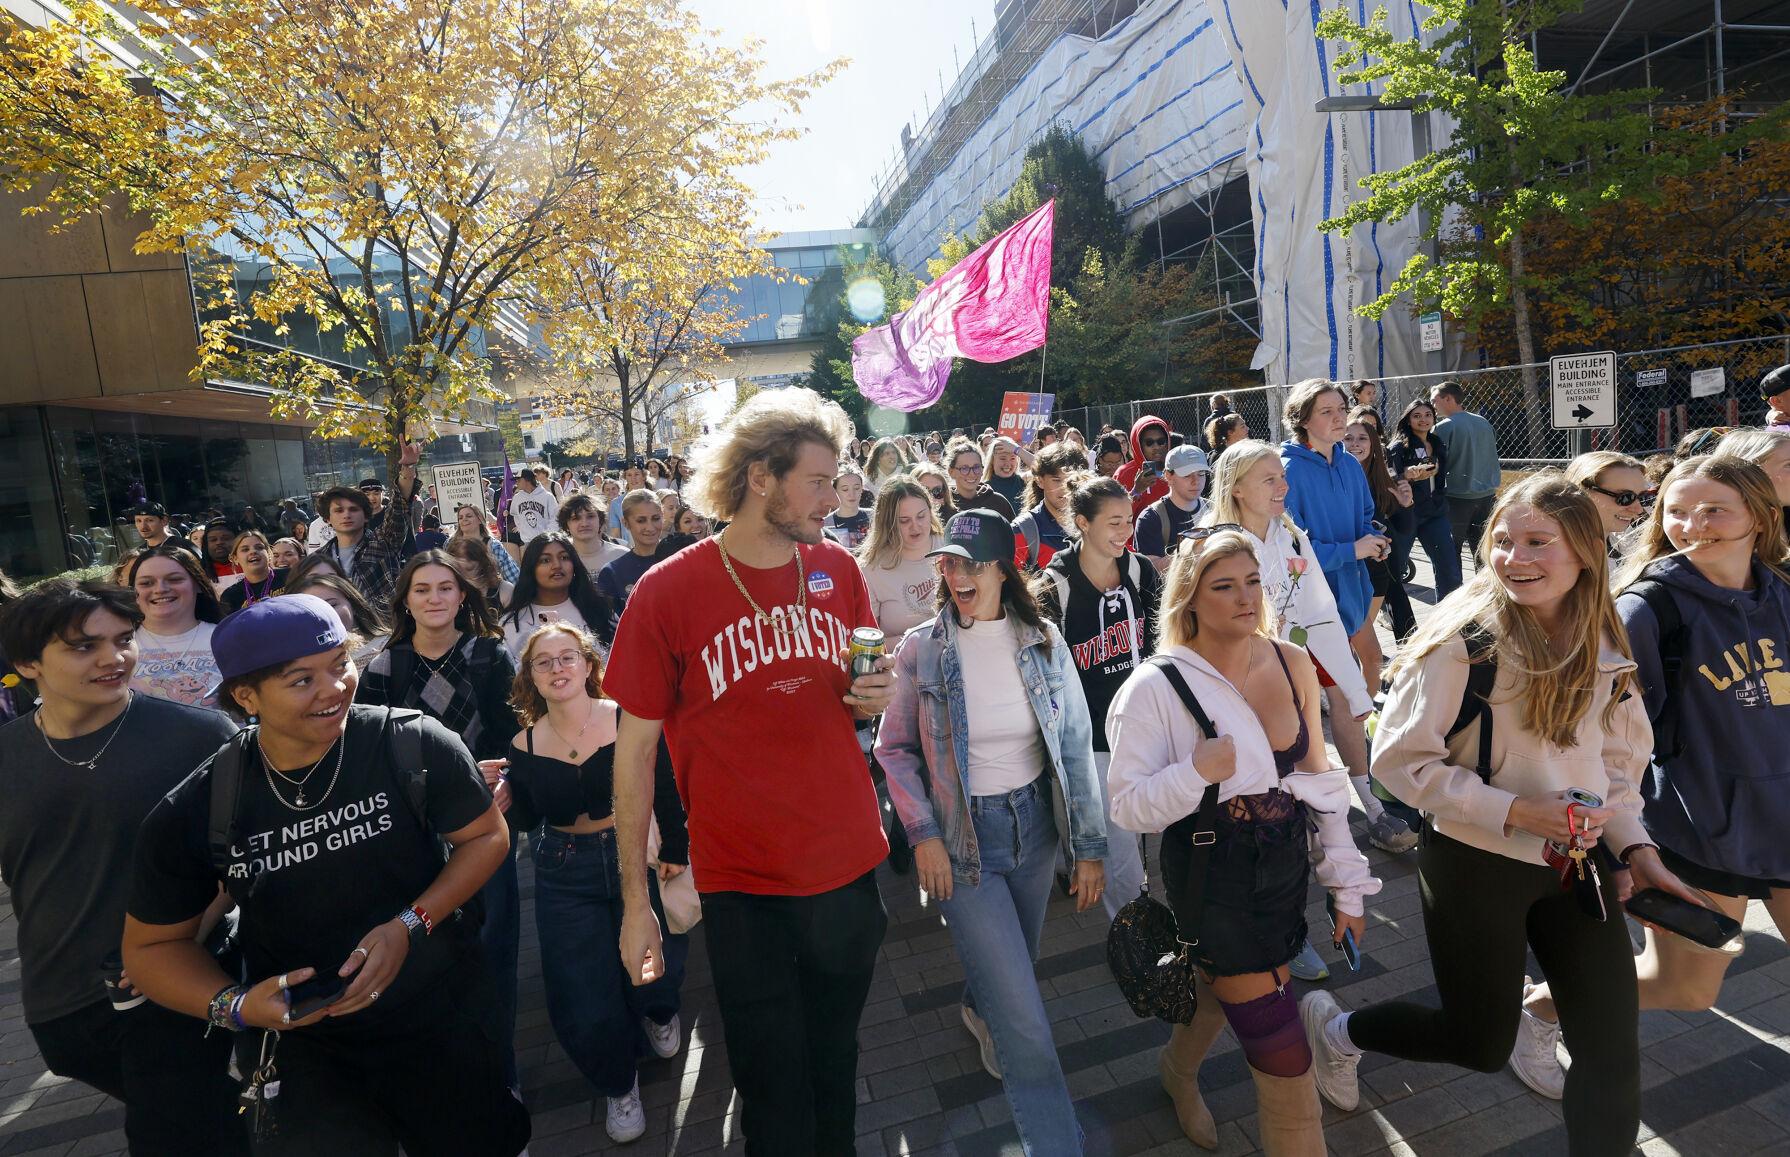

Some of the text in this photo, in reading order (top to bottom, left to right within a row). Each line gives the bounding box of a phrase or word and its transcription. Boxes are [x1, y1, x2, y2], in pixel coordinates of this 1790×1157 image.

[1558, 357, 1607, 370] ELVEHJEM
[1560, 369, 1606, 381] BUILDING
[1575, 380, 1609, 388] ENTRANCE
[1565, 387, 1601, 395] ACCESSIBLE
[1001, 413, 1049, 429] GO VOTE
[439, 468, 475, 478] ELVEHJEM
[441, 477, 475, 487] BUILDING
[701, 604, 848, 701] WISCONSIN
[281, 792, 389, 844] NERVOUS
[326, 814, 393, 851] GIRLS
